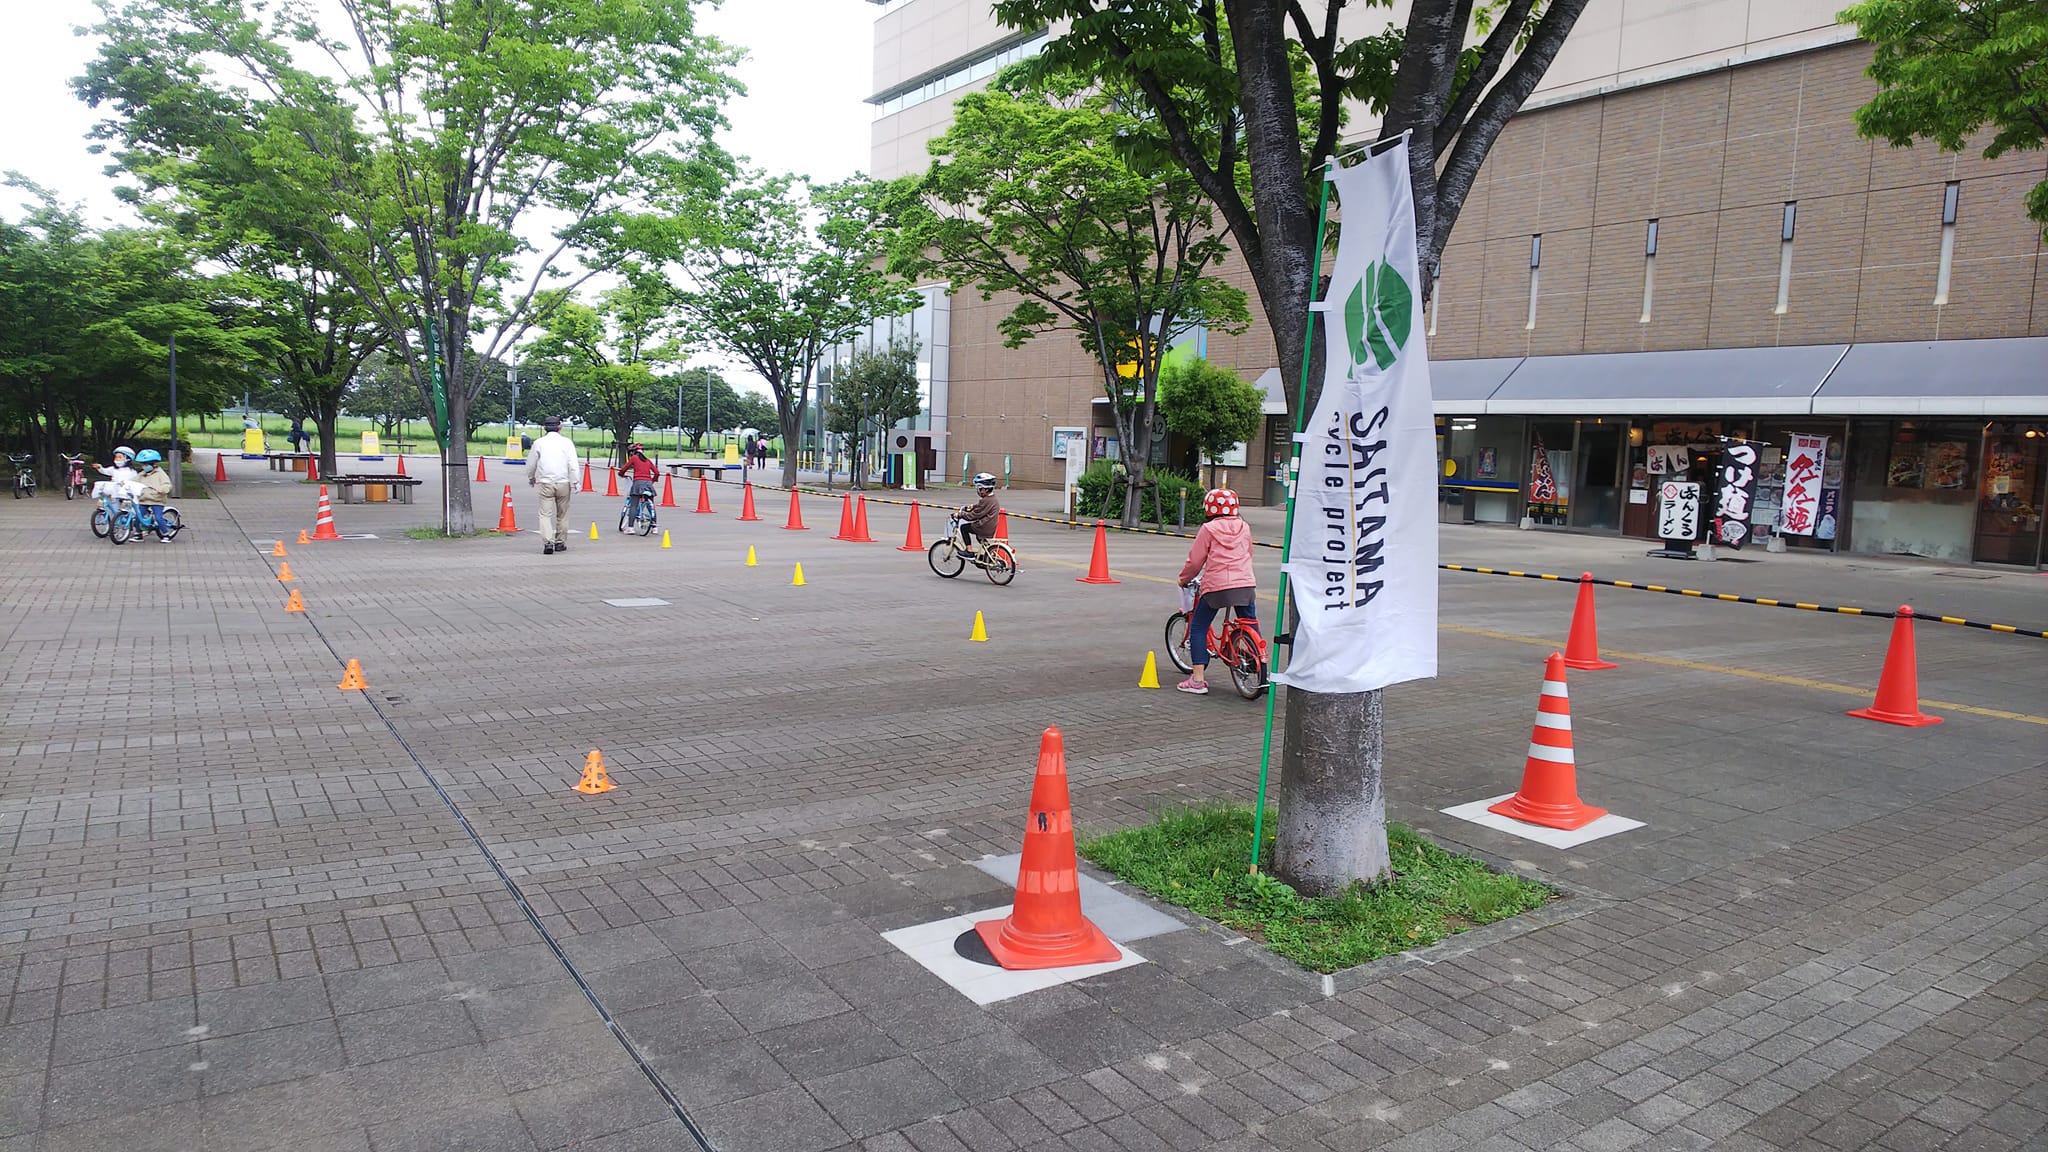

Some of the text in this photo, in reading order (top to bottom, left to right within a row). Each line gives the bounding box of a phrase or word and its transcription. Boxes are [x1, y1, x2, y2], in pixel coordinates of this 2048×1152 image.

[1152, 421, 1164, 435] A2
[1350, 406, 1389, 608] SAITAMA
[1663, 500, 1676, 535] ラーメン
[1716, 445, 1757, 521] つけ麺
[1323, 507, 1351, 610] project
